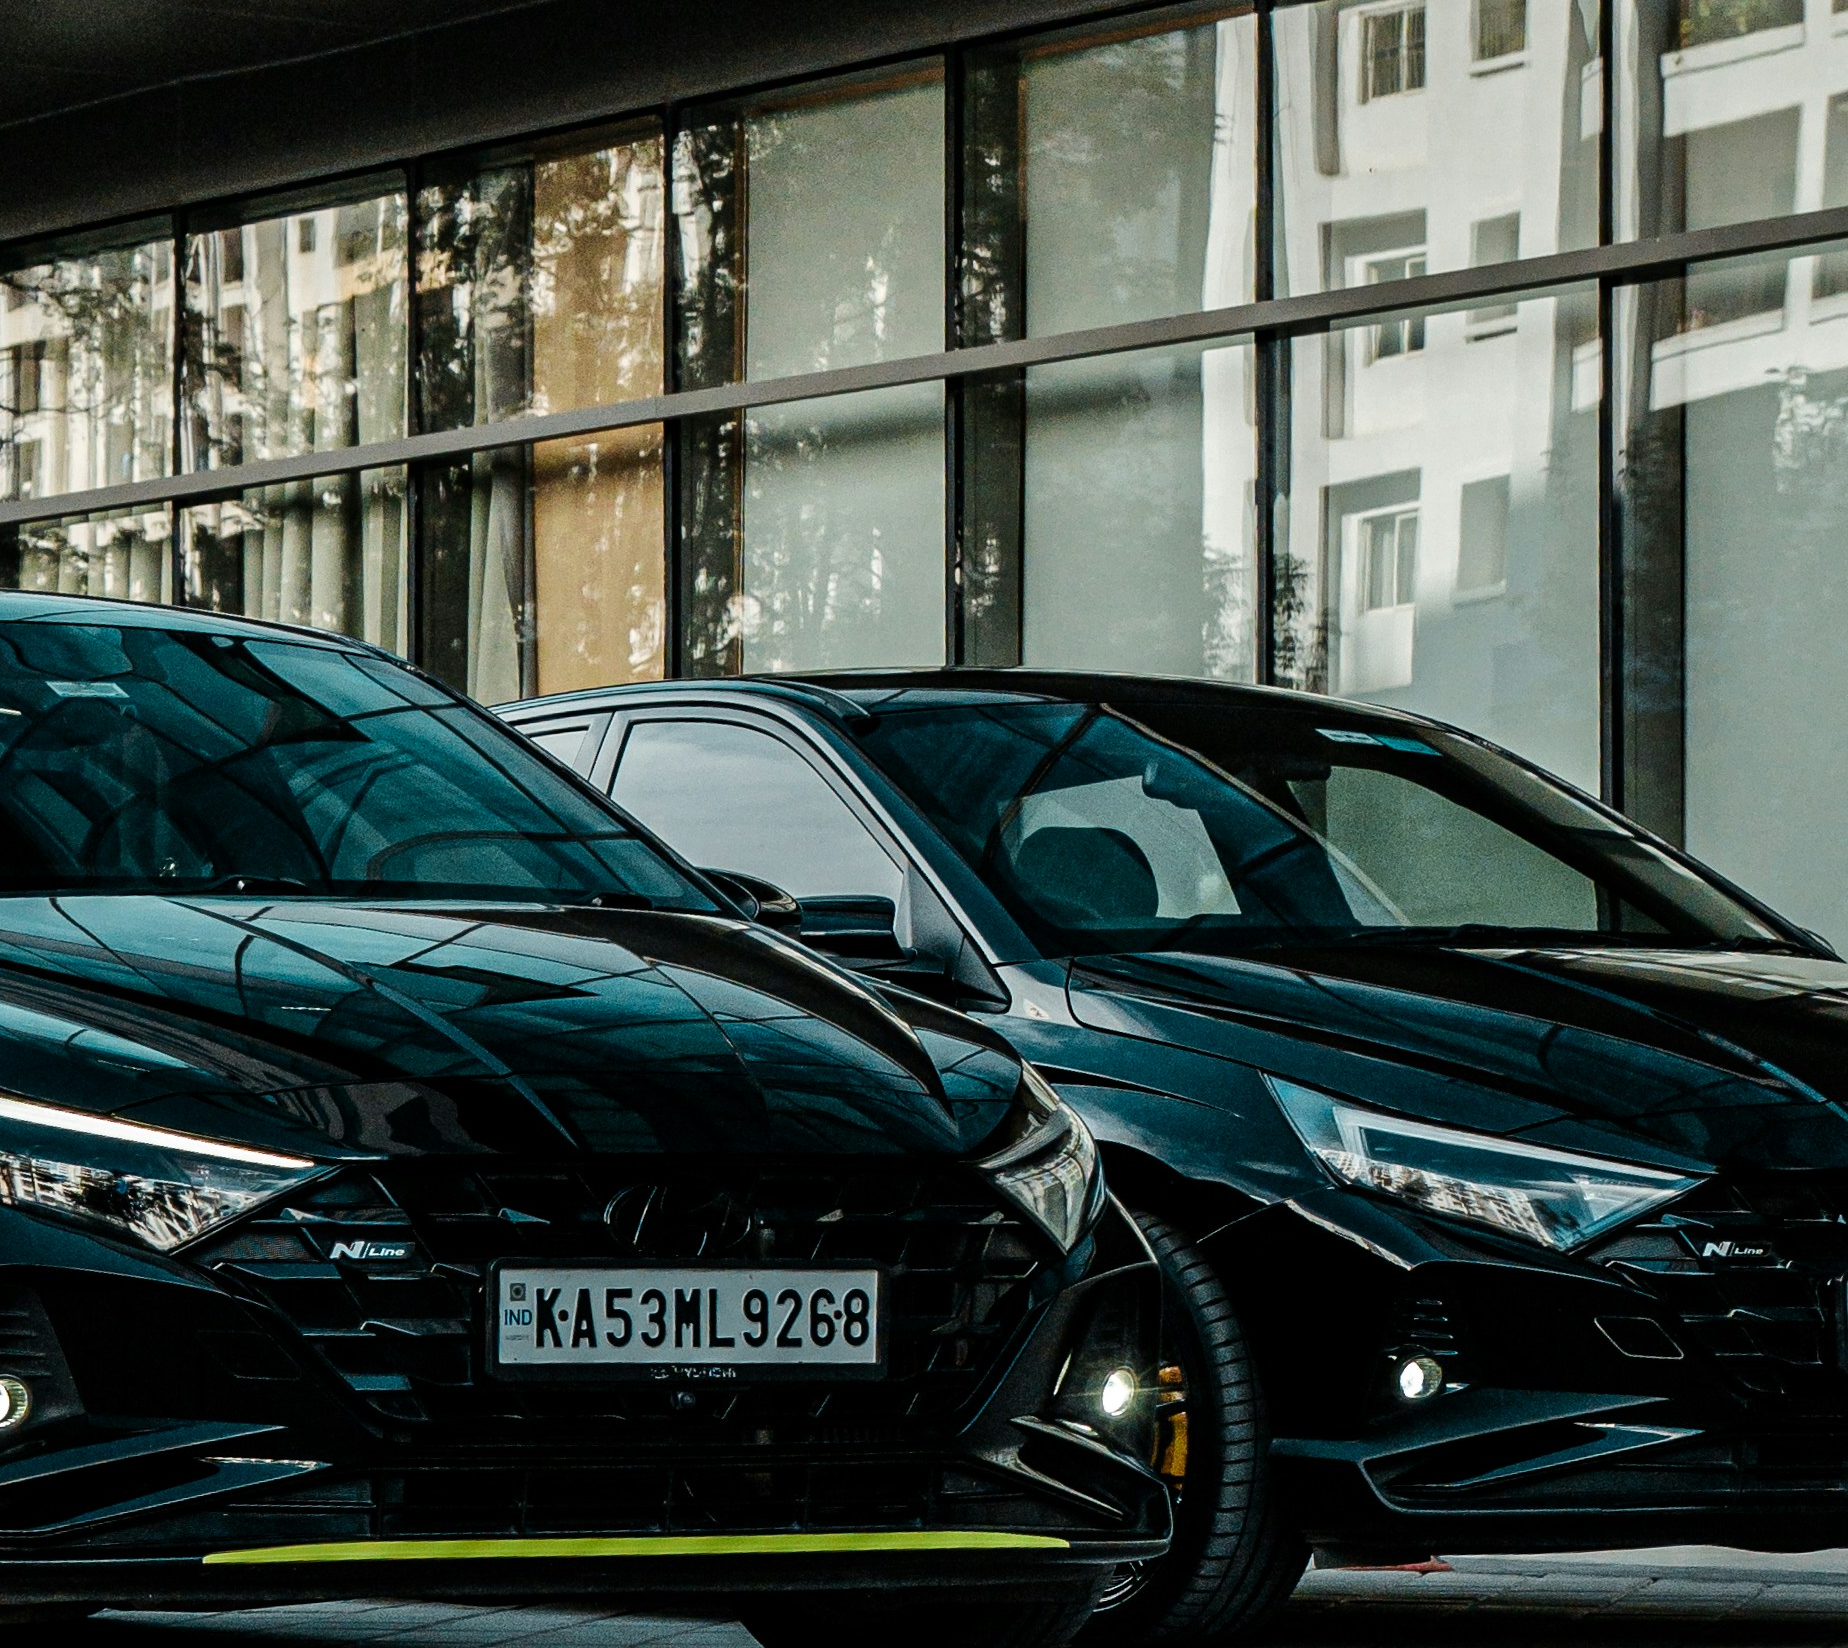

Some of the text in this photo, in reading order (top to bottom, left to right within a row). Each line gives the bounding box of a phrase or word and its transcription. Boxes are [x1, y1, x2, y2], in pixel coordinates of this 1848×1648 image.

[368, 1247, 406, 1257] Line
[504, 1308, 533, 1326] IND
[534, 1287, 871, 1349] KA53ML9268
